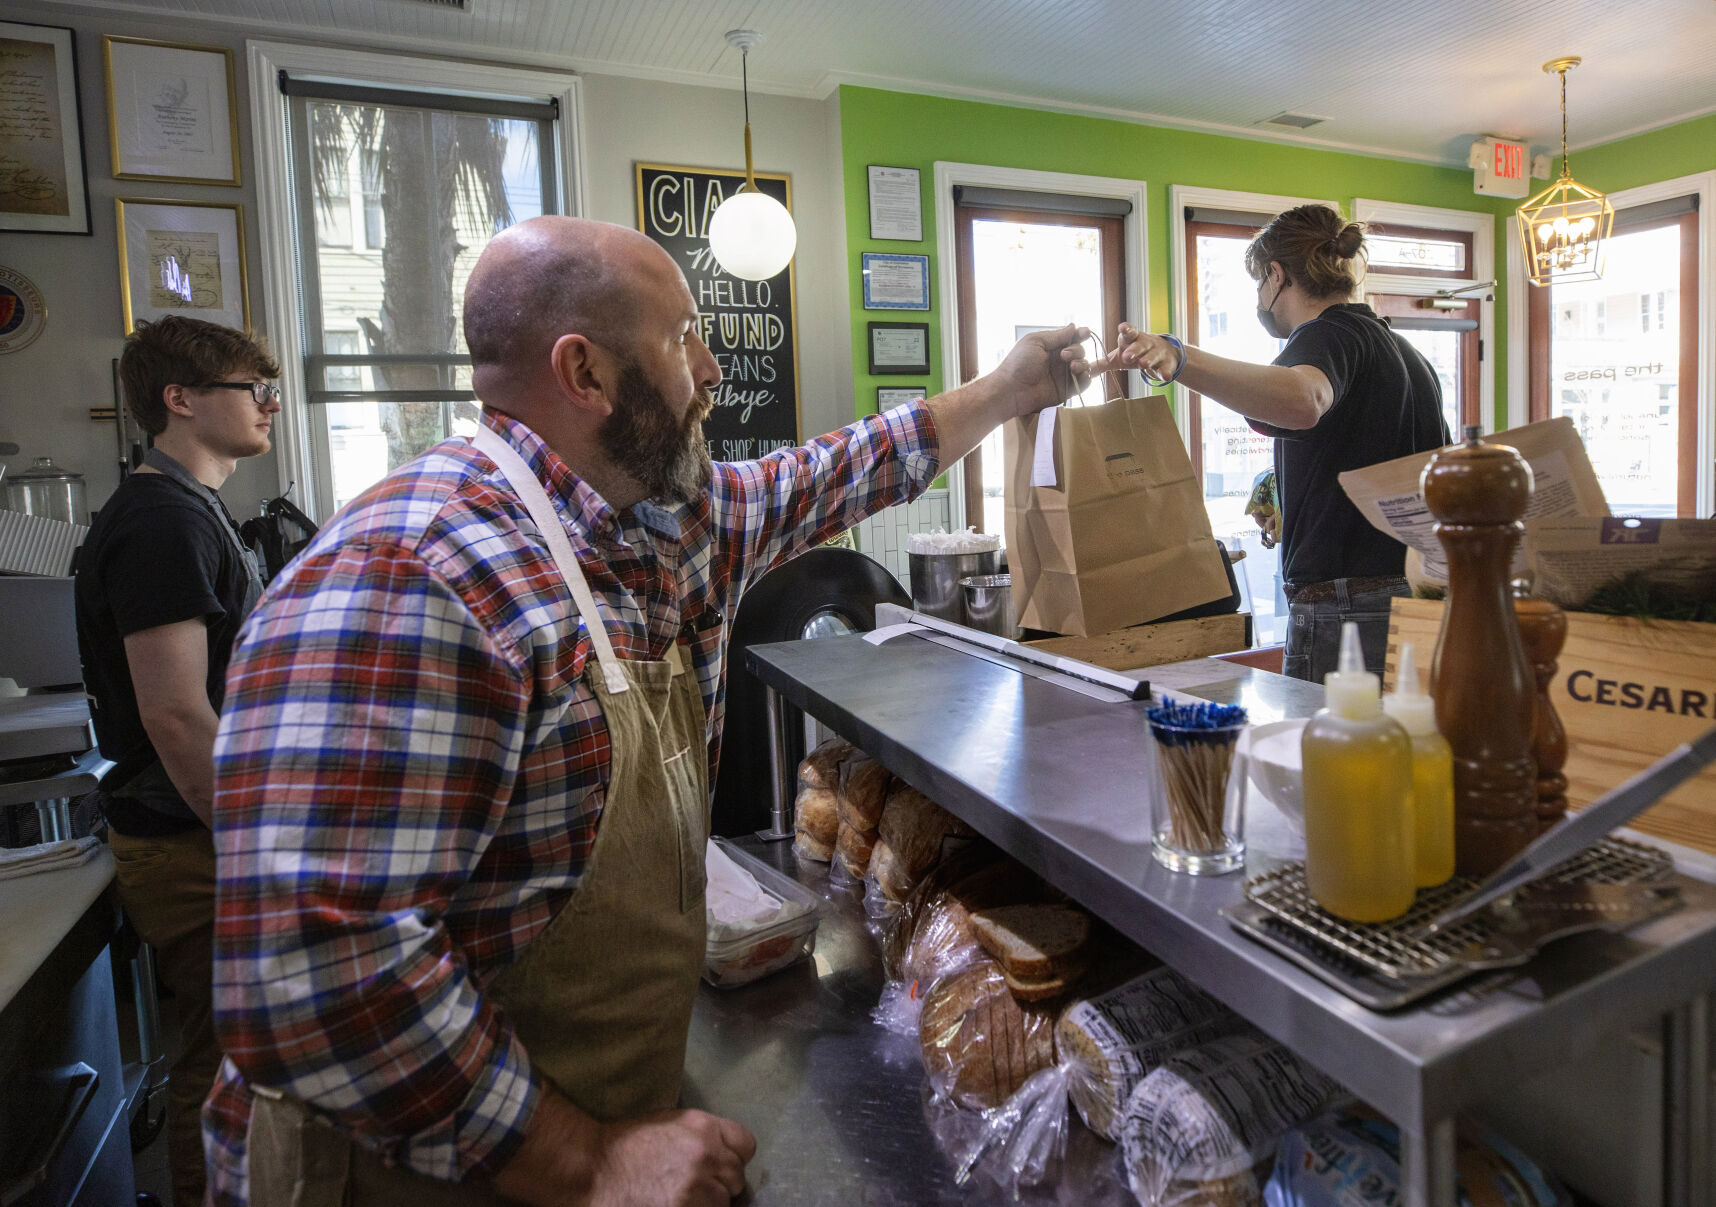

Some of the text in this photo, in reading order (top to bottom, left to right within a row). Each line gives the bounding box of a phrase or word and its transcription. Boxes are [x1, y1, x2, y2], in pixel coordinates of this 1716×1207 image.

[1494, 142, 1525, 181] EXIT
[649, 174, 747, 239] CIA
[714, 353, 777, 383] EANS
[722, 439, 752, 462] SHOP
